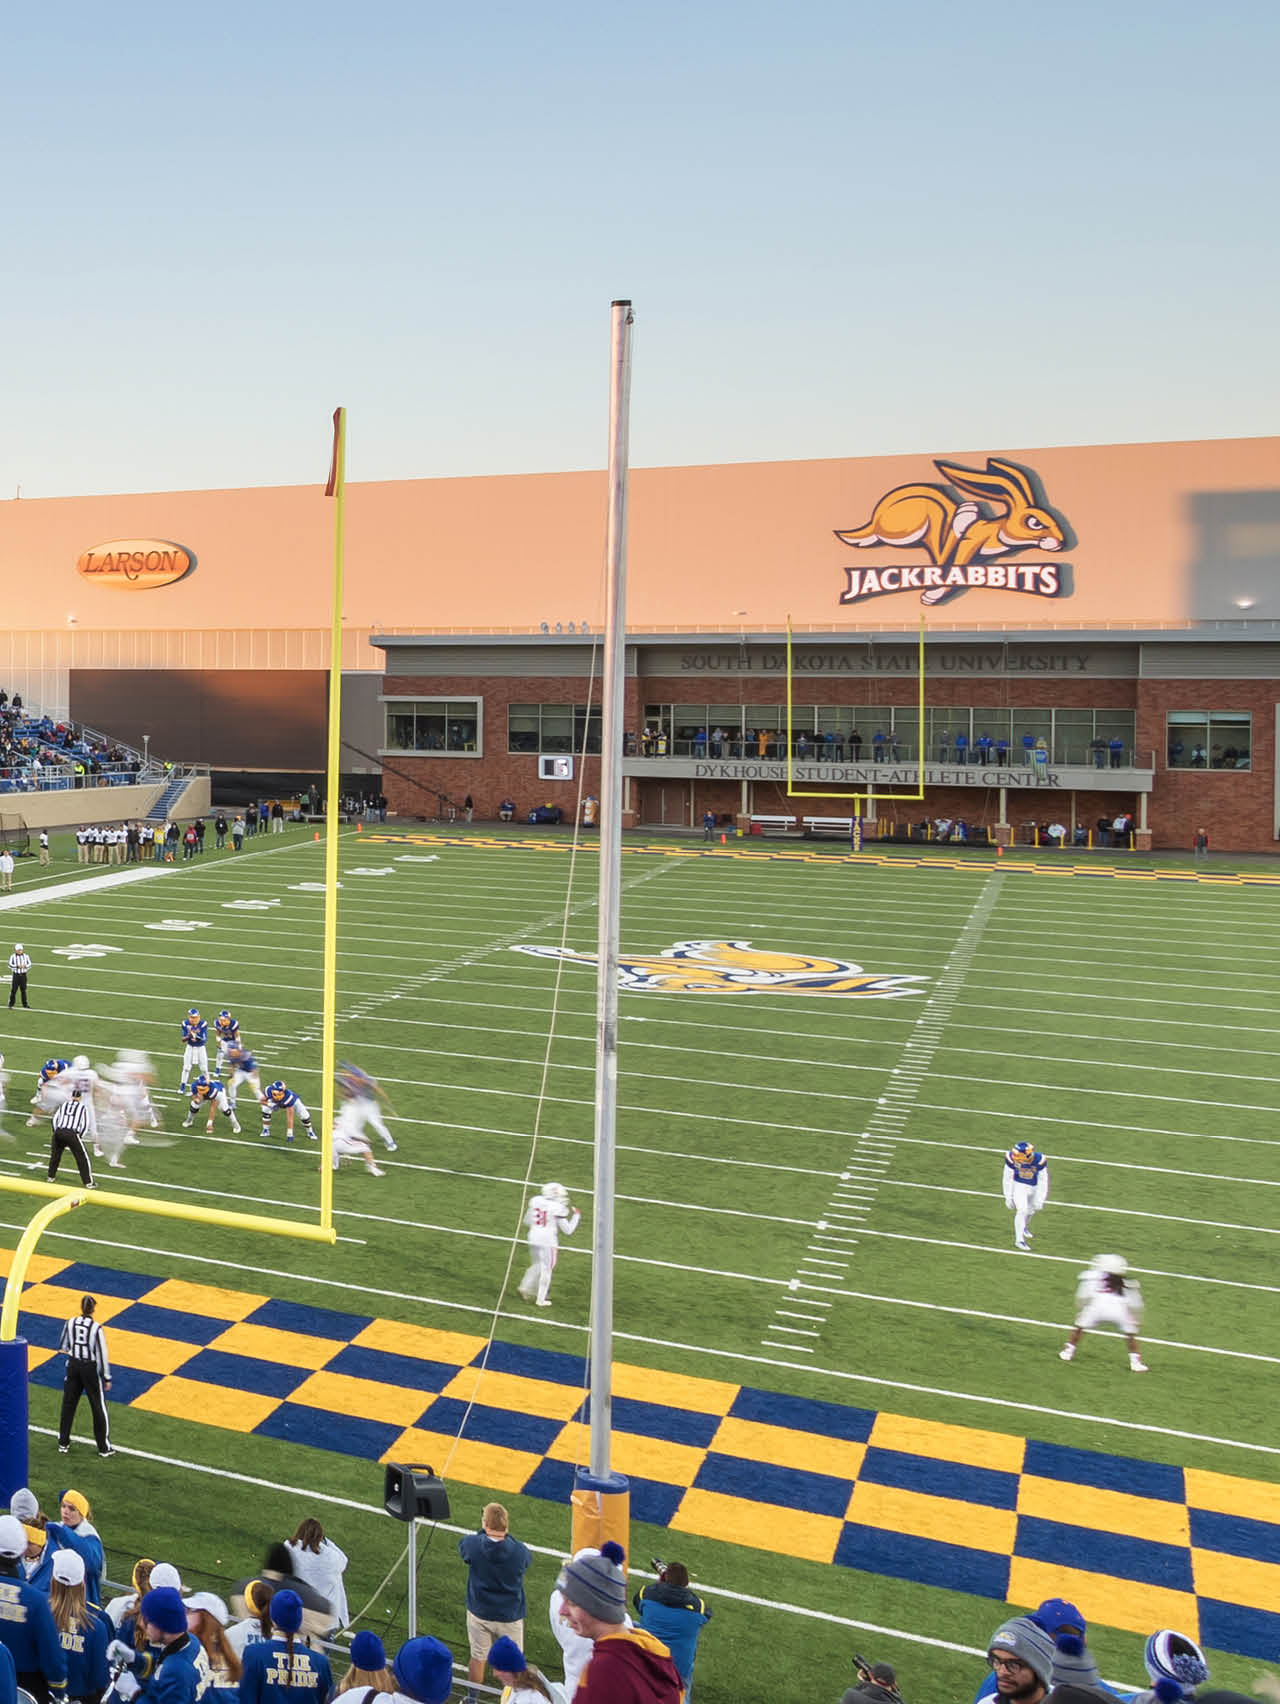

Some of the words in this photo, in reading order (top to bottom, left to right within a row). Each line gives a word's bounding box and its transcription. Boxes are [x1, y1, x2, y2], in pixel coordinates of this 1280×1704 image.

[82, 550, 179, 581] LARSON
[843, 565, 1058, 600] JACKRABBITS
[680, 655, 752, 670] SOUTH
[762, 655, 852, 670] DAKOTA
[941, 655, 1089, 671] UNIVERSITY
[75, 1325, 89, 1344] B
